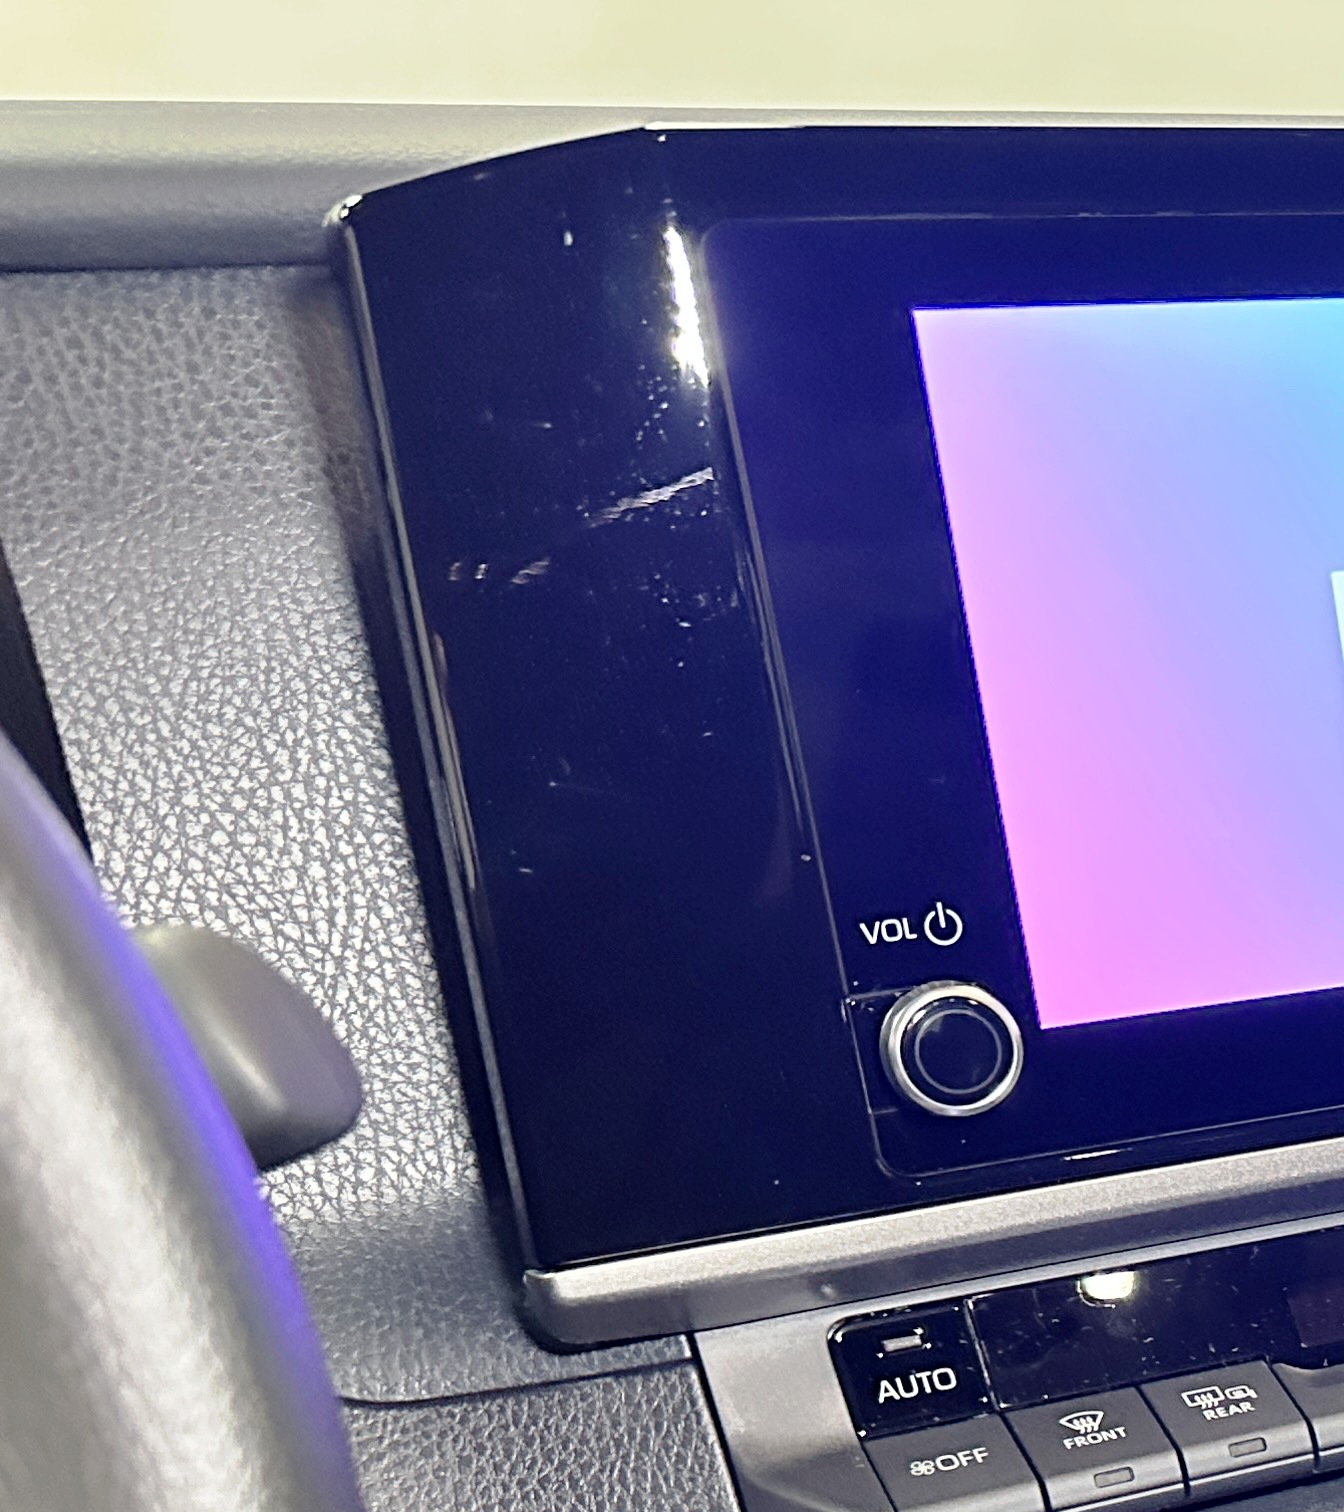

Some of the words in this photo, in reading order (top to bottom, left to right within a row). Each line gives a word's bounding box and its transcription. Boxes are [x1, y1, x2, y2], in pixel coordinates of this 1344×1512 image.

[859, 917, 918, 944] VOL
[878, 1367, 957, 1403] AUTO
[1202, 1401, 1255, 1421] REAR
[1063, 1426, 1126, 1450] FRONT
[935, 1447, 989, 1473] OFF
